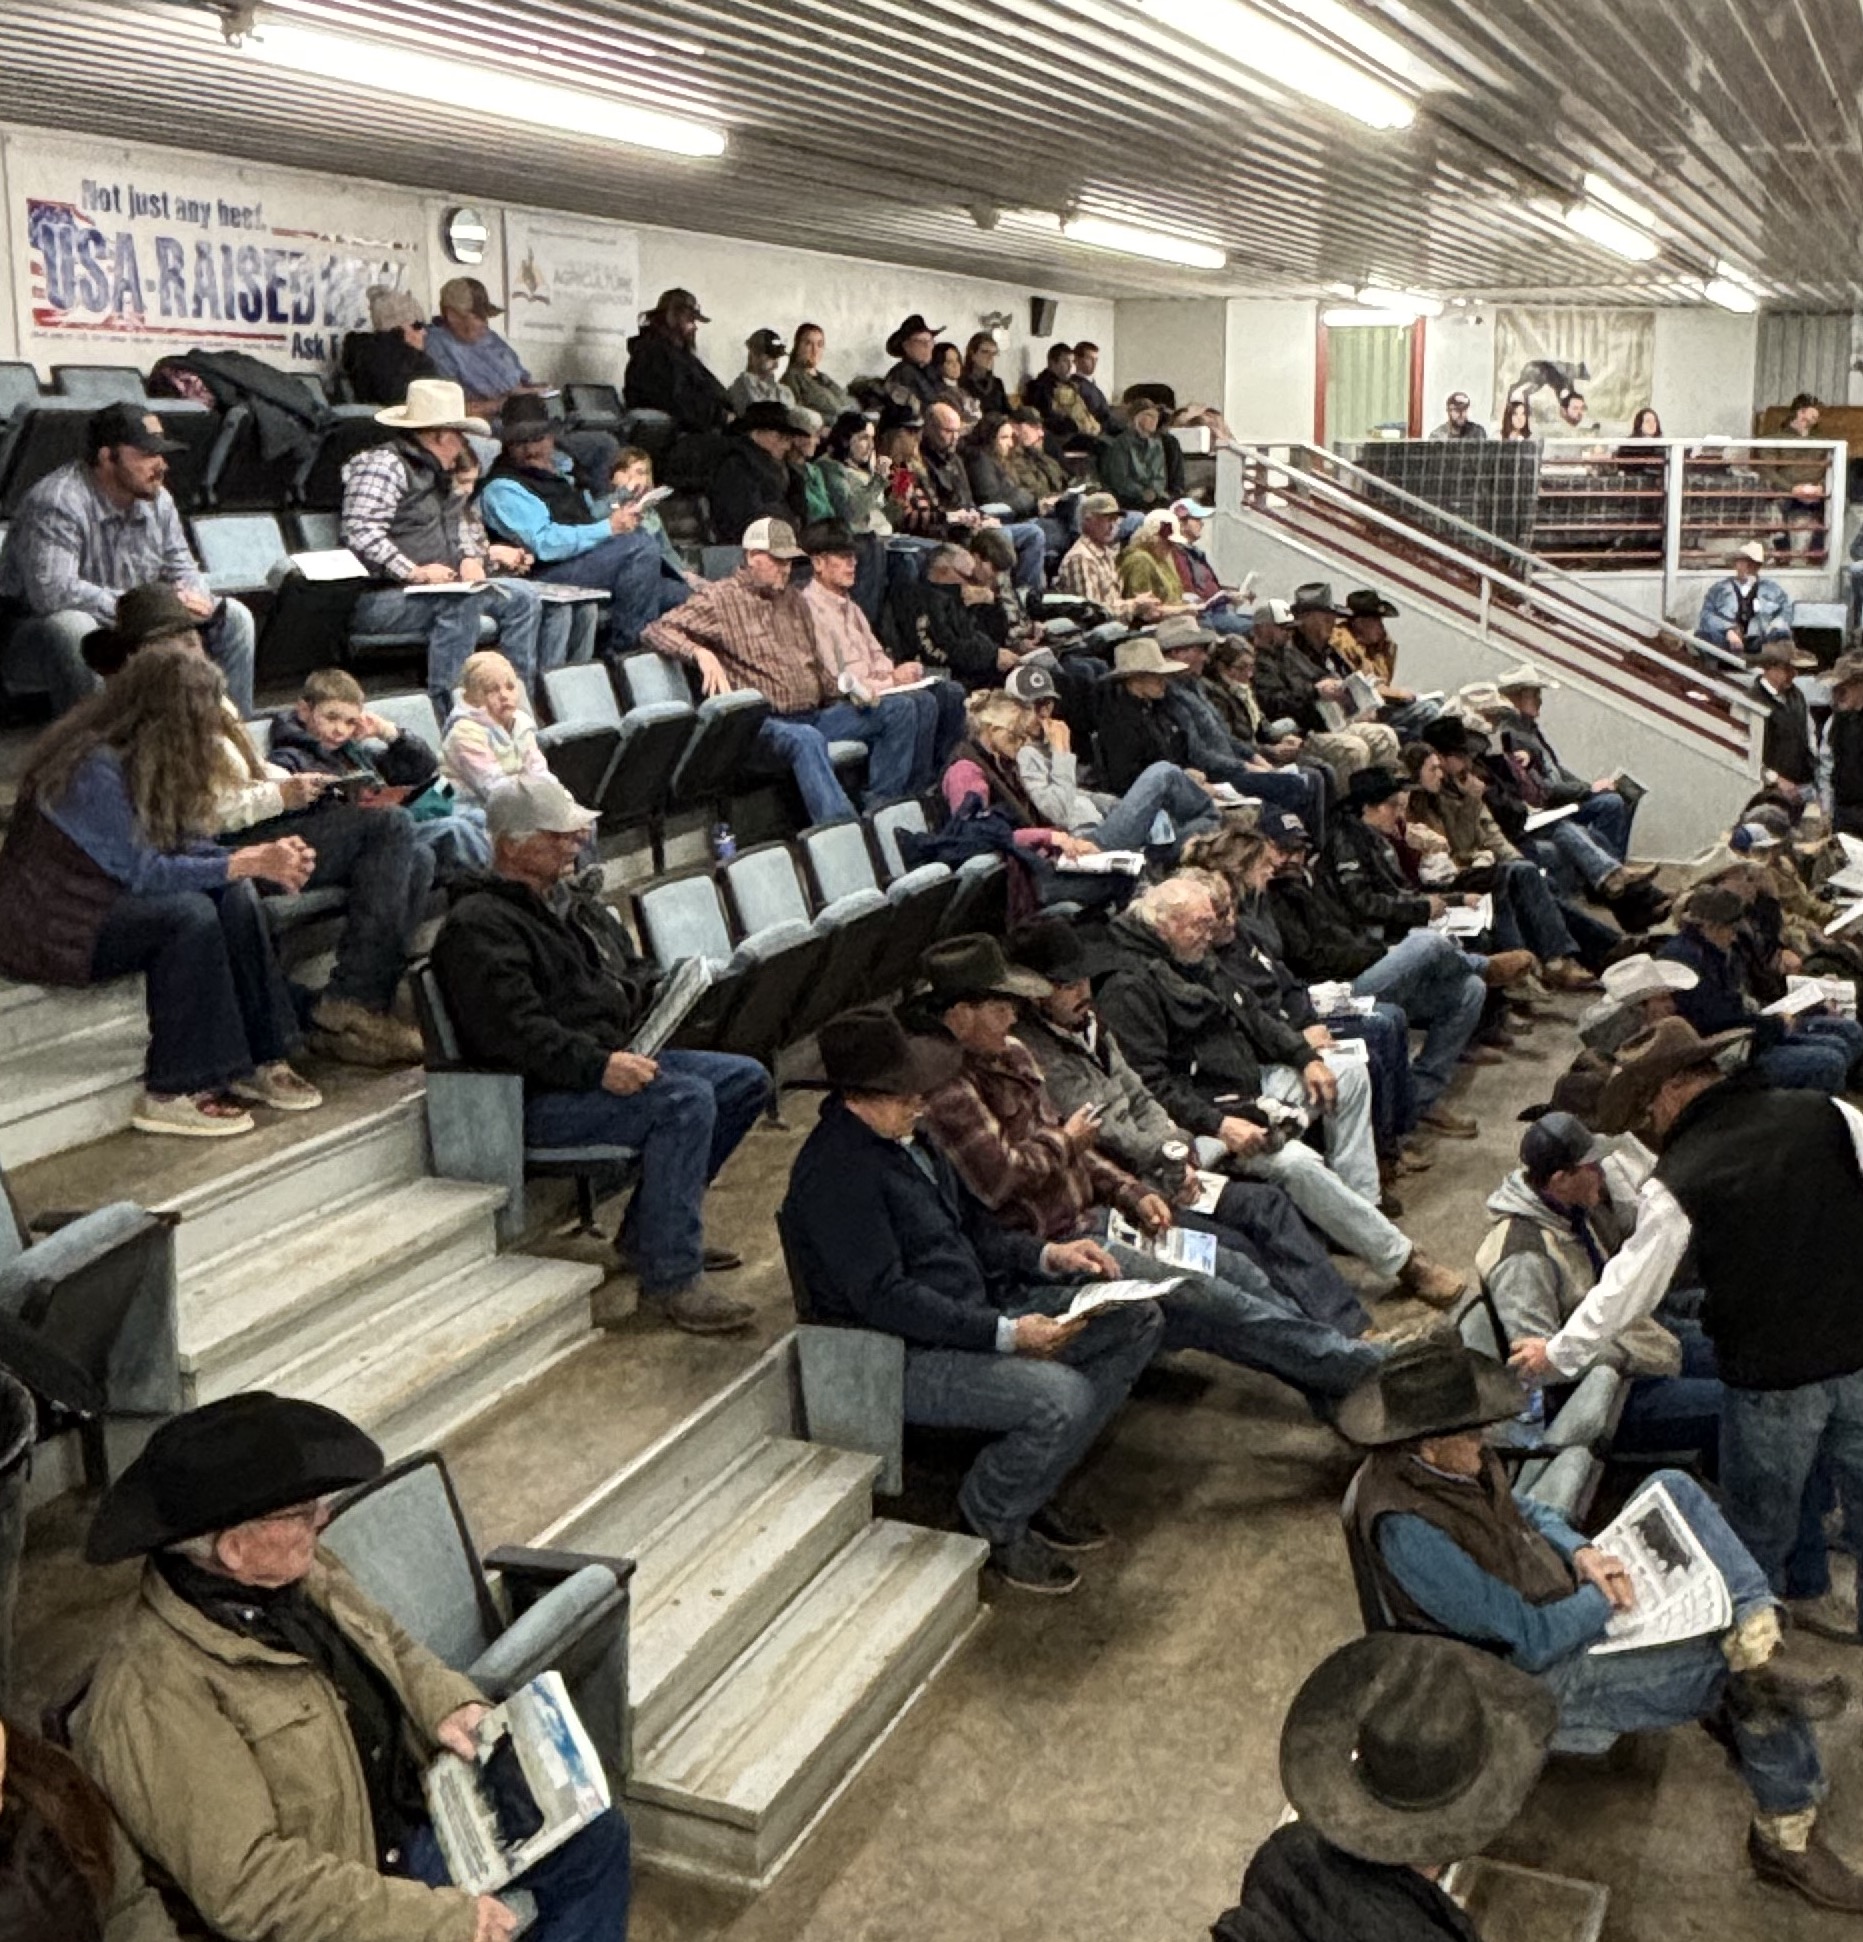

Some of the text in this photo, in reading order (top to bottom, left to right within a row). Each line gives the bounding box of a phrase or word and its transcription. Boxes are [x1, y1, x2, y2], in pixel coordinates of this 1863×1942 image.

[81, 179, 121, 214] Not
[127, 184, 170, 220] just
[174, 195, 211, 230] any
[292, 331, 326, 361] Ask
